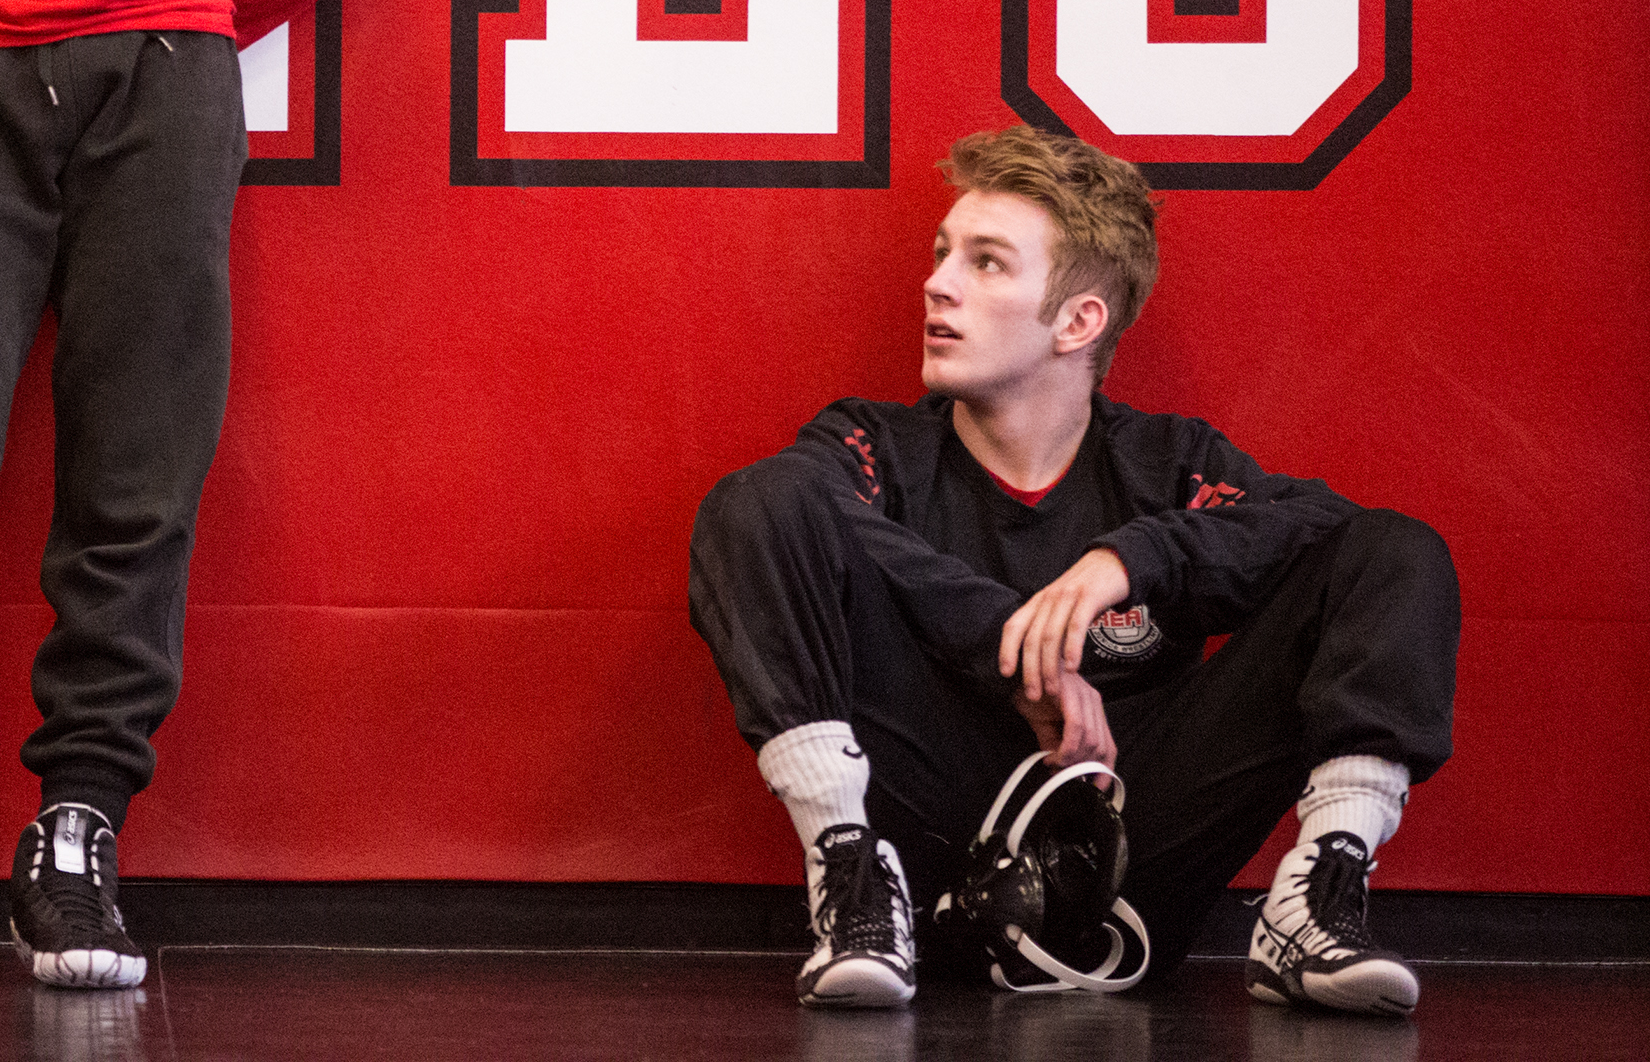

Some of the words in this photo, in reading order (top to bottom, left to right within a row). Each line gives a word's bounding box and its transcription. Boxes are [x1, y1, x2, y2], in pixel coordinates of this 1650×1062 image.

[1093, 608, 1142, 627] REA
[67, 809, 78, 834] asics
[835, 829, 862, 844] asics
[1343, 843, 1366, 860] asics
